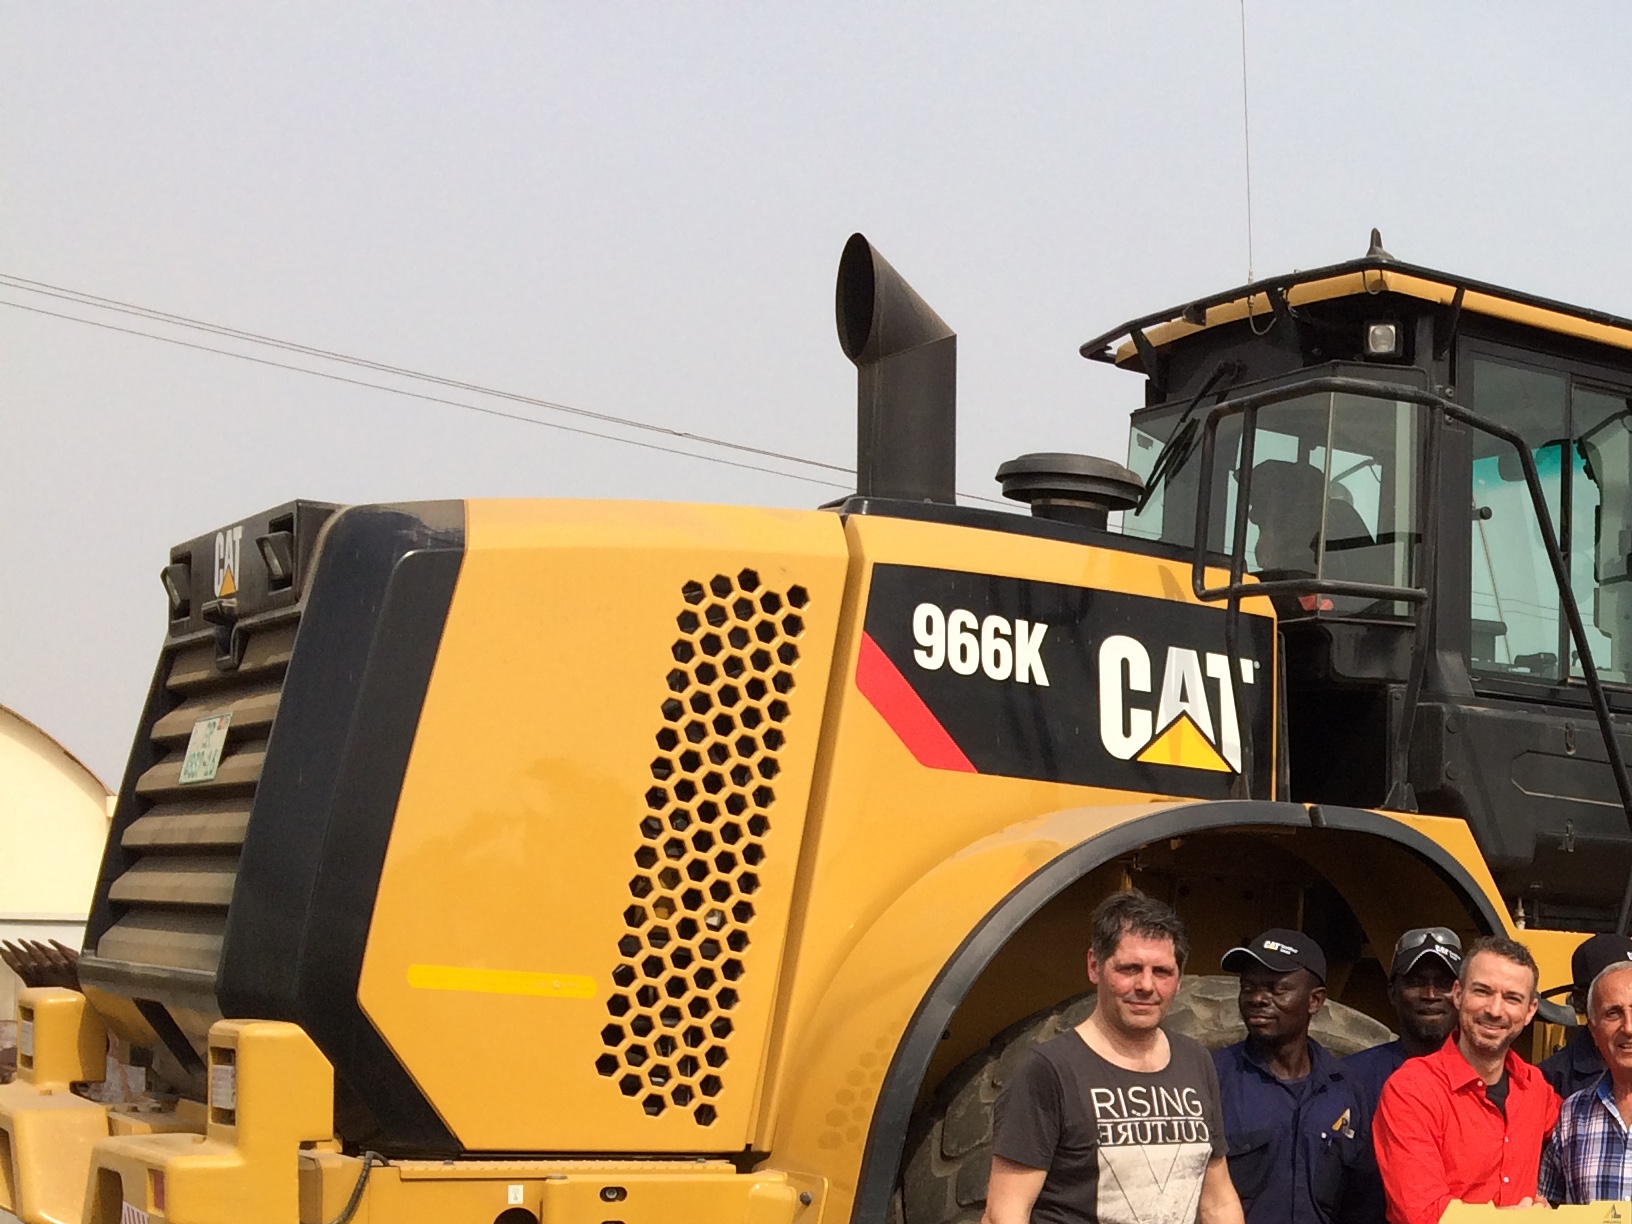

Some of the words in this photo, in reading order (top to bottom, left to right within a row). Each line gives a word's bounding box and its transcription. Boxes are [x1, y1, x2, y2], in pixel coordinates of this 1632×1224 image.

[214, 525, 243, 597] CAT
[912, 602, 1050, 687] 966K
[1098, 635, 1255, 774] CAT
[1263, 940, 1280, 951] CAT
[1090, 1085, 1203, 1118] RISING
